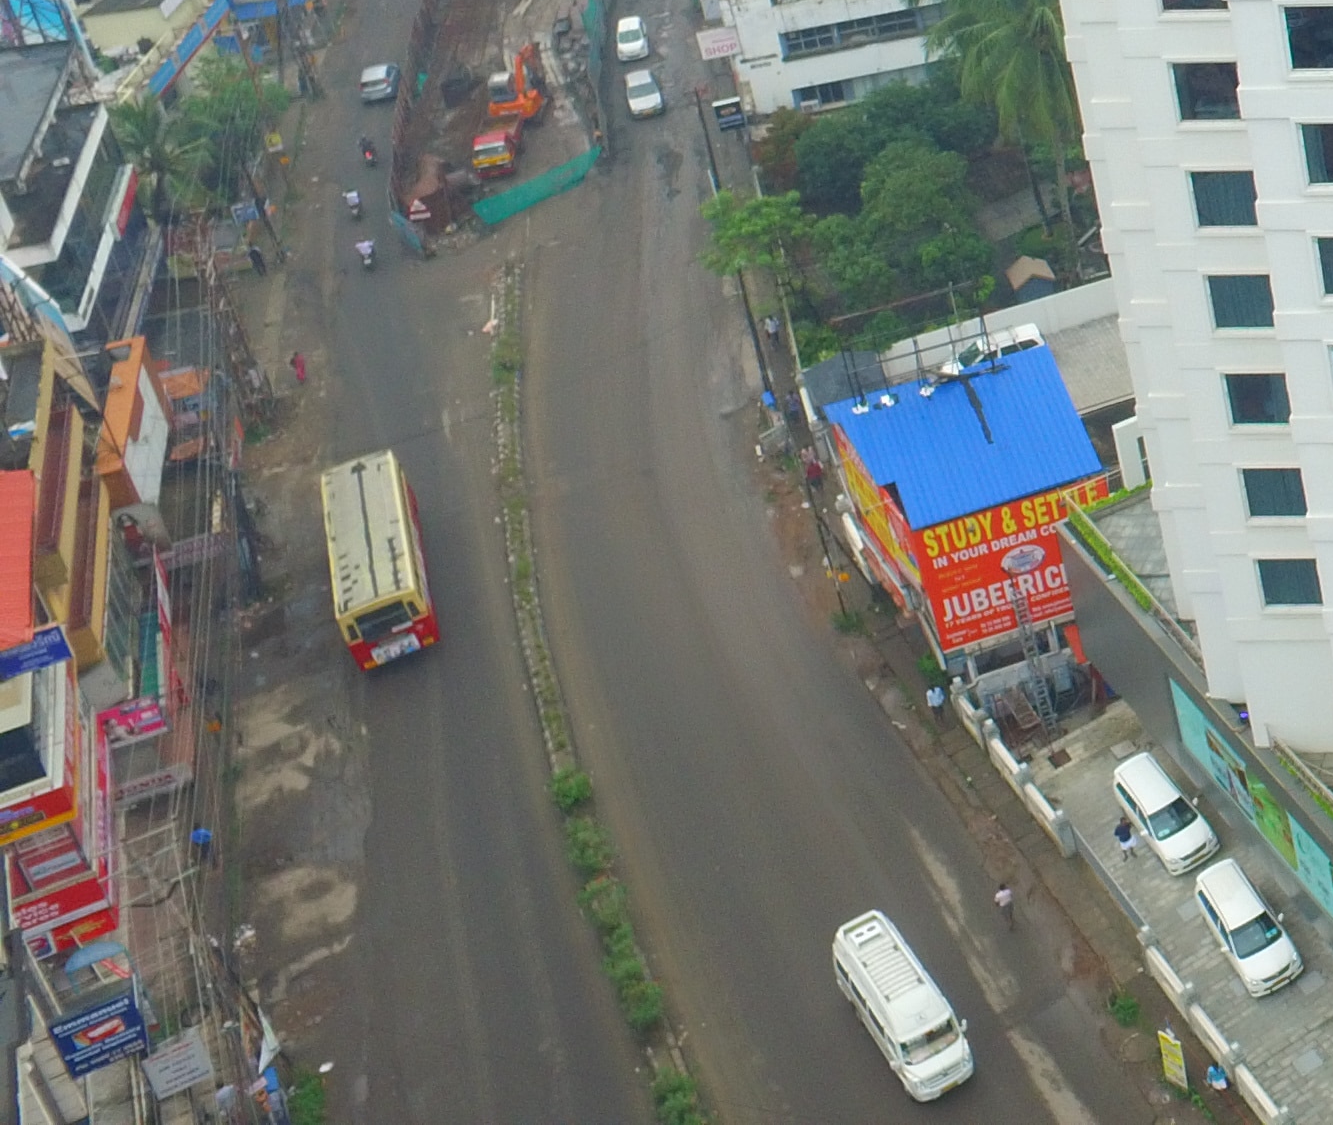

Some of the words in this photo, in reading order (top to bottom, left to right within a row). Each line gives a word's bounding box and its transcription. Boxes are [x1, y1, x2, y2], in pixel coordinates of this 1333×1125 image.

[704, 42, 737, 56] SHOP
[923, 512, 993, 557] STUDY
[1002, 506, 1018, 535] &
[932, 556, 948, 569] IN
[950, 544, 989, 563] YOUR
[991, 531, 1038, 551] DREAM
[52, 998, 130, 1035] Emmanuel
